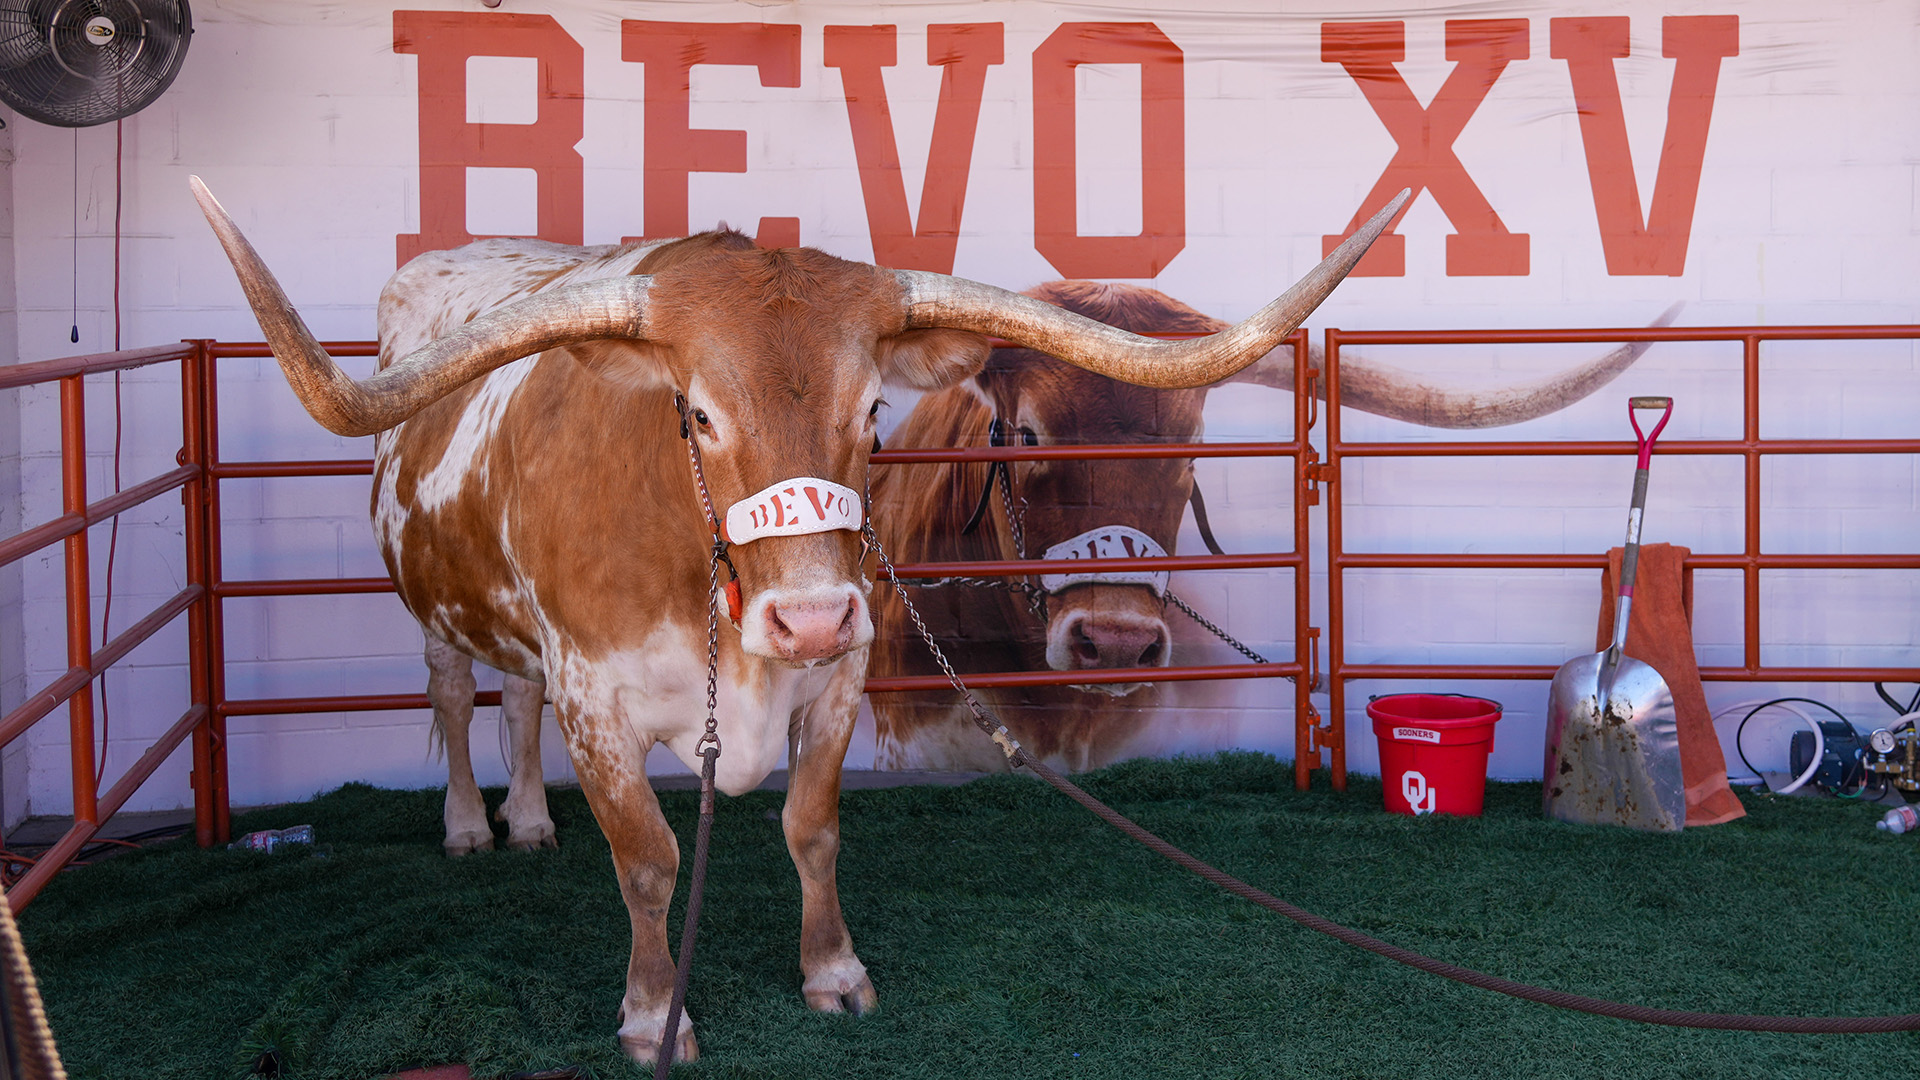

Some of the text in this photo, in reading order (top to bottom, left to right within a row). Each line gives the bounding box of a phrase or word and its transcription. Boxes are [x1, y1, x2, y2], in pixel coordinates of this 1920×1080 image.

[393, 10, 1739, 279] BEVO XV
[750, 486, 850, 530] BEVO
[1398, 728, 1434, 739] SOONERS
[1402, 770, 1436, 816] OU
